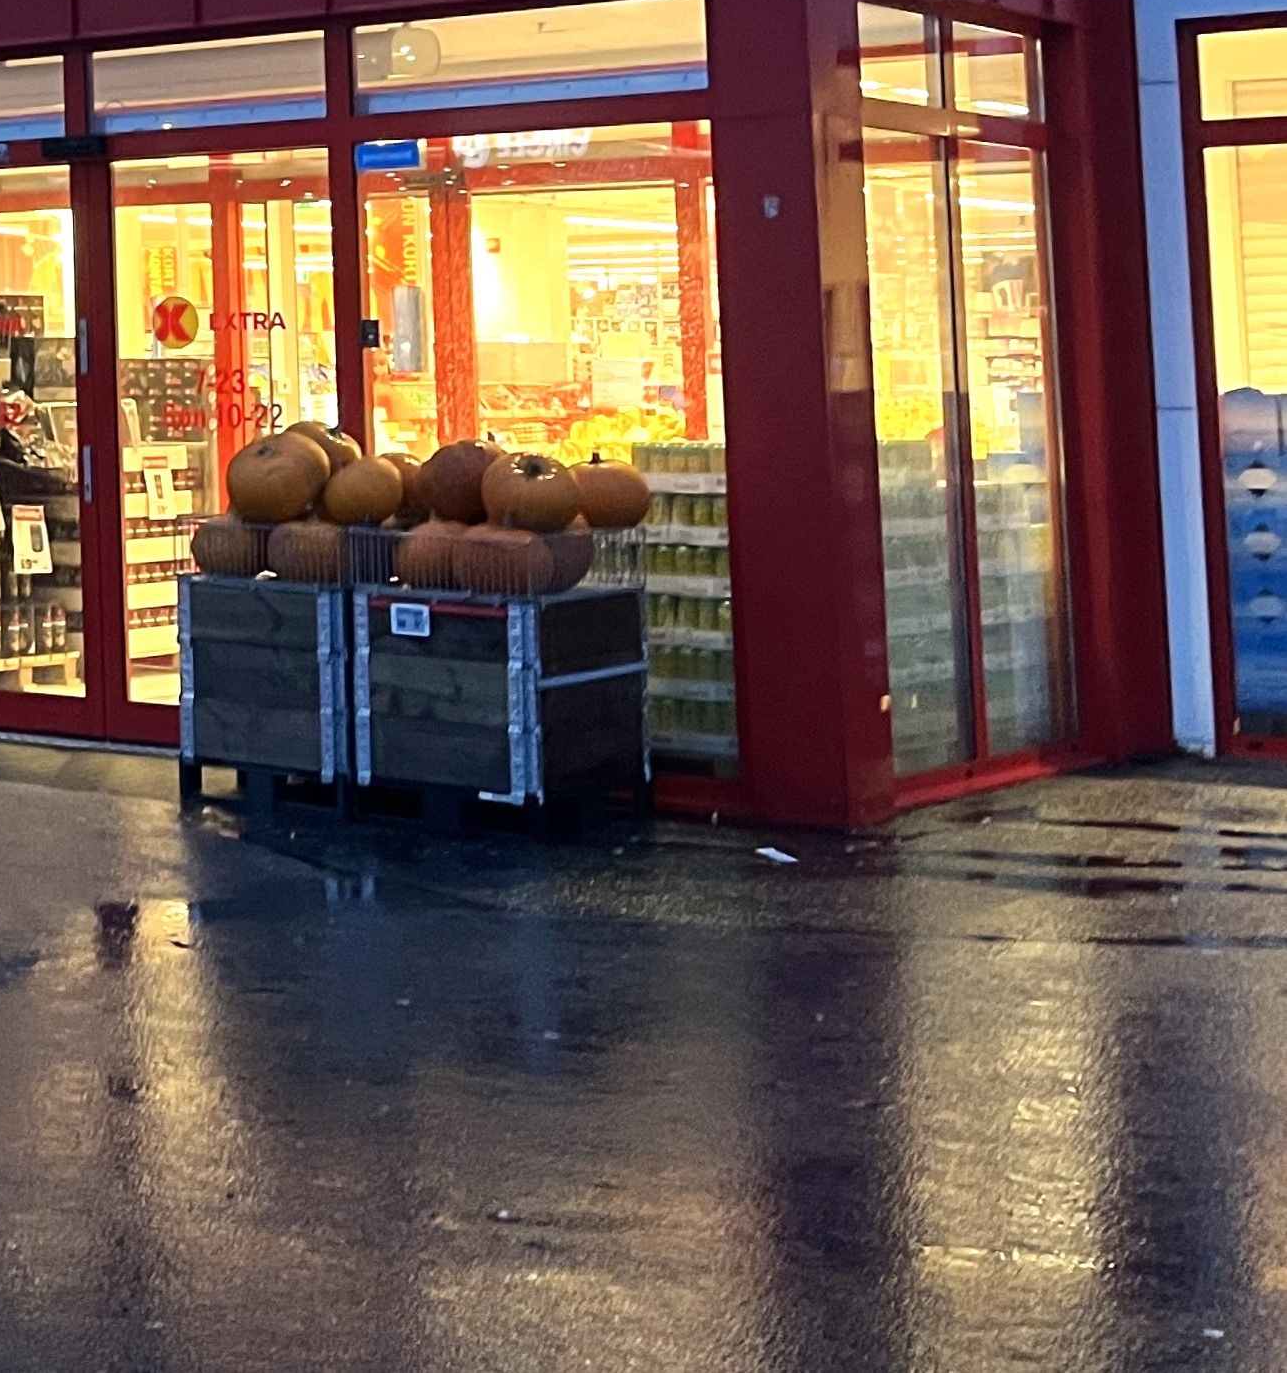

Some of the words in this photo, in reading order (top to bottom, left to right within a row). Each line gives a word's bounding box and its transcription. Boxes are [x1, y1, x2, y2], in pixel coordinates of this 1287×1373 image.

[209, 312, 286, 331] EXTRA
[195, 368, 245, 395] 7-23
[216, 403, 284, 429] 10-22
